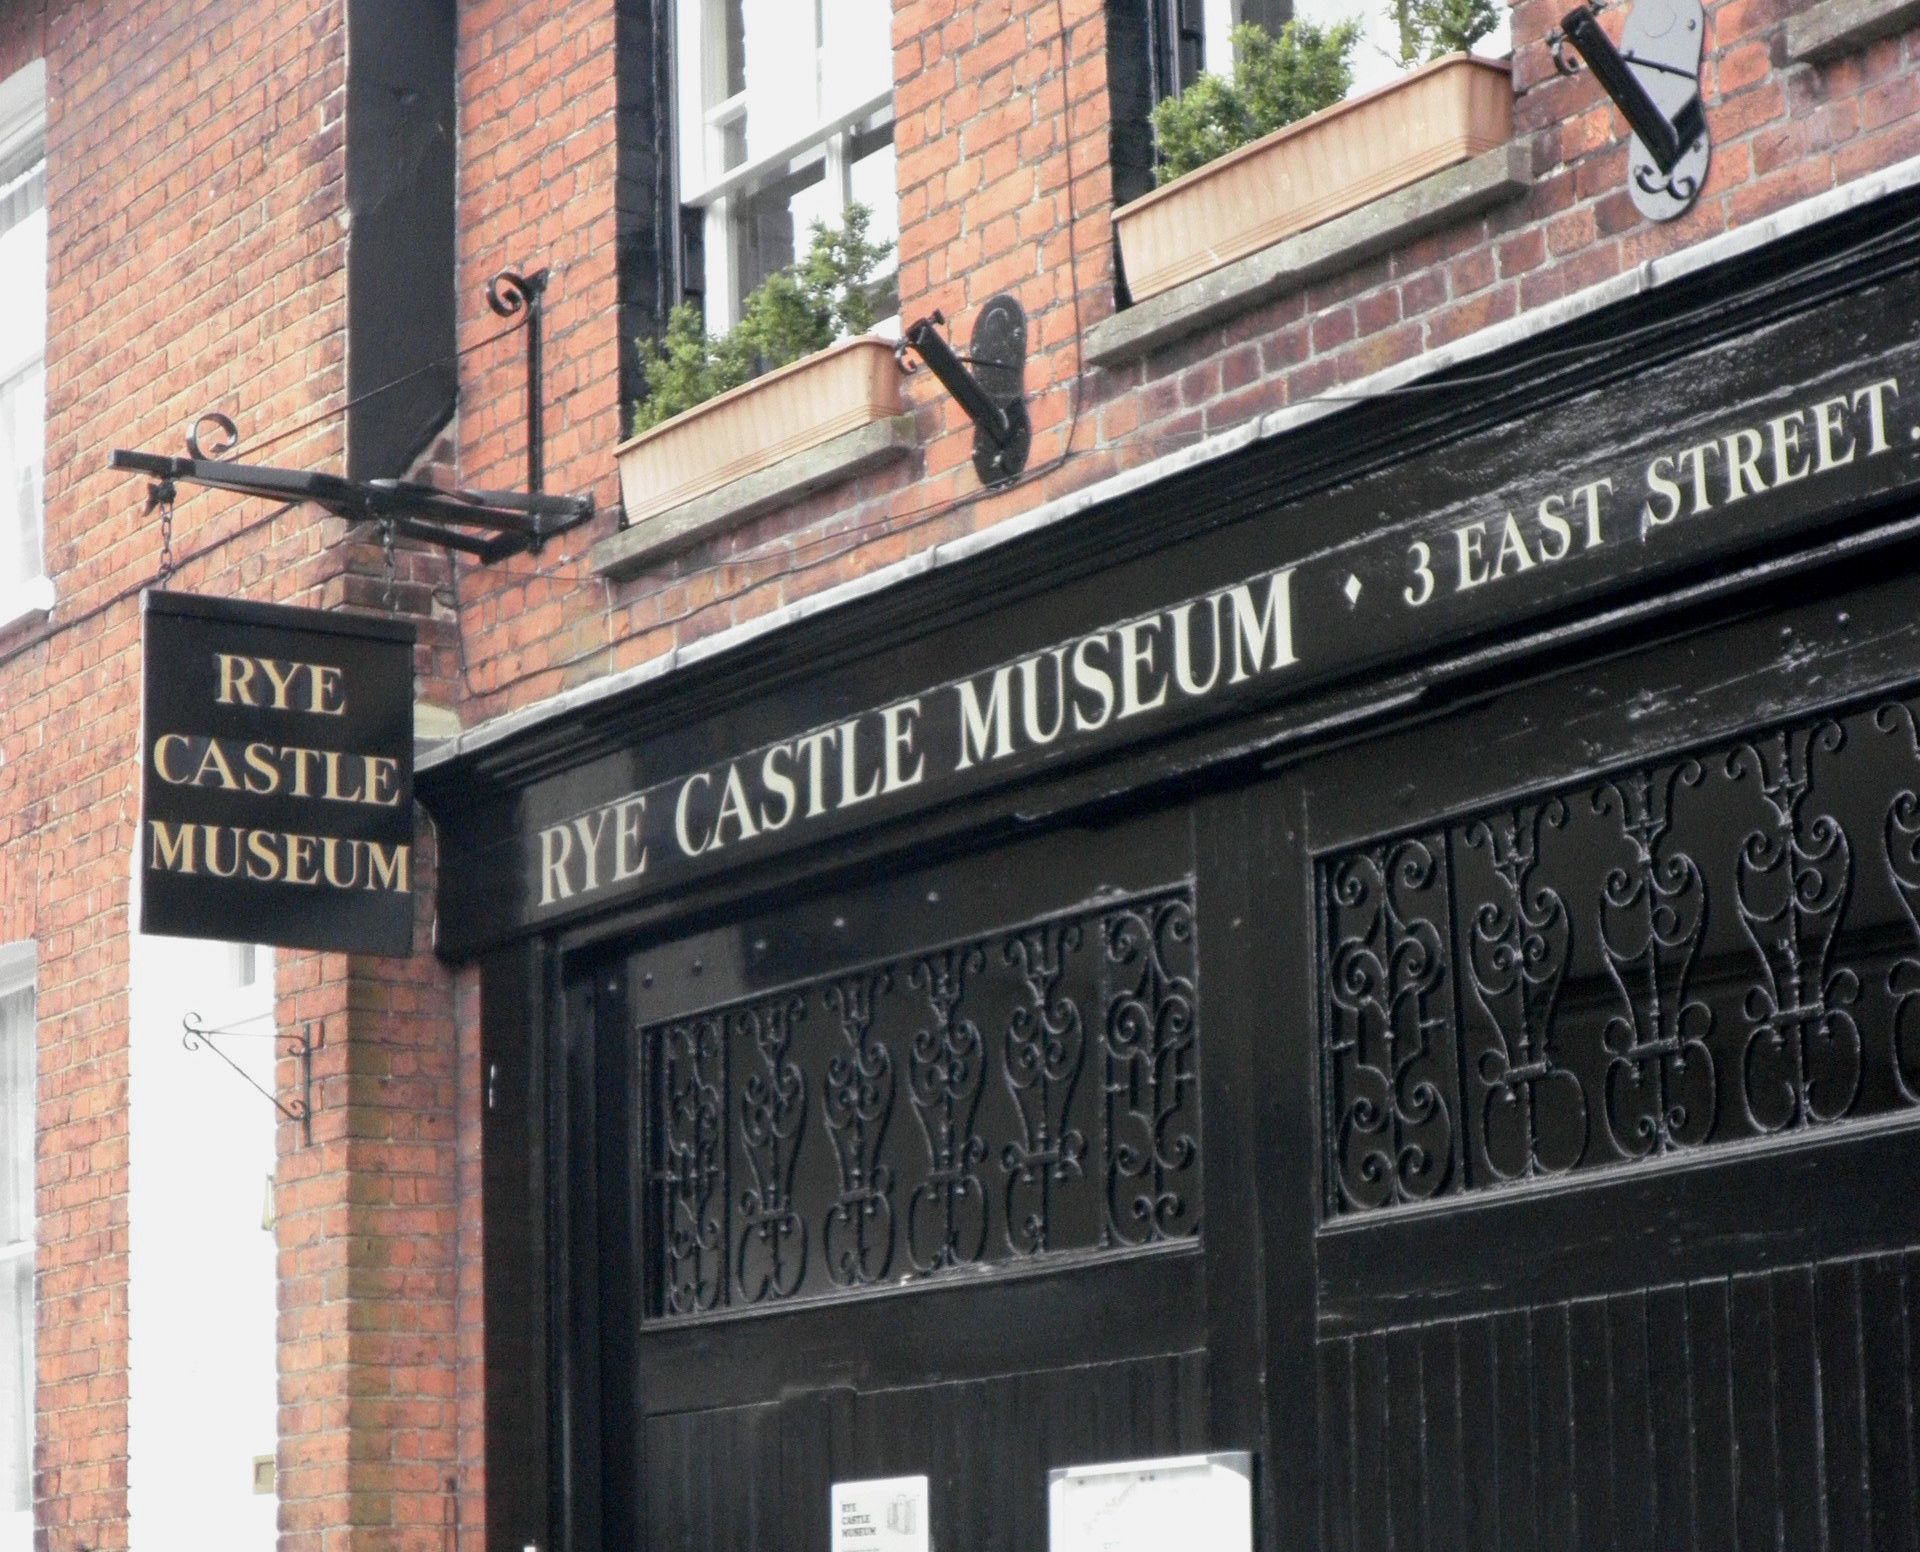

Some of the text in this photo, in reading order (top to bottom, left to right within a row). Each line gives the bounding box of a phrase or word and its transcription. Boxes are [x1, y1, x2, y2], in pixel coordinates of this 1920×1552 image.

[214, 652, 346, 717] RYE
[537, 795, 648, 907] RYE
[674, 698, 926, 857] CASTLE
[952, 567, 1301, 771] MUSEUM
[1403, 540, 1435, 607] 3
[1455, 476, 1614, 593] EAST
[152, 733, 400, 806] CASTLE
[148, 820, 411, 894] MUSEUM
